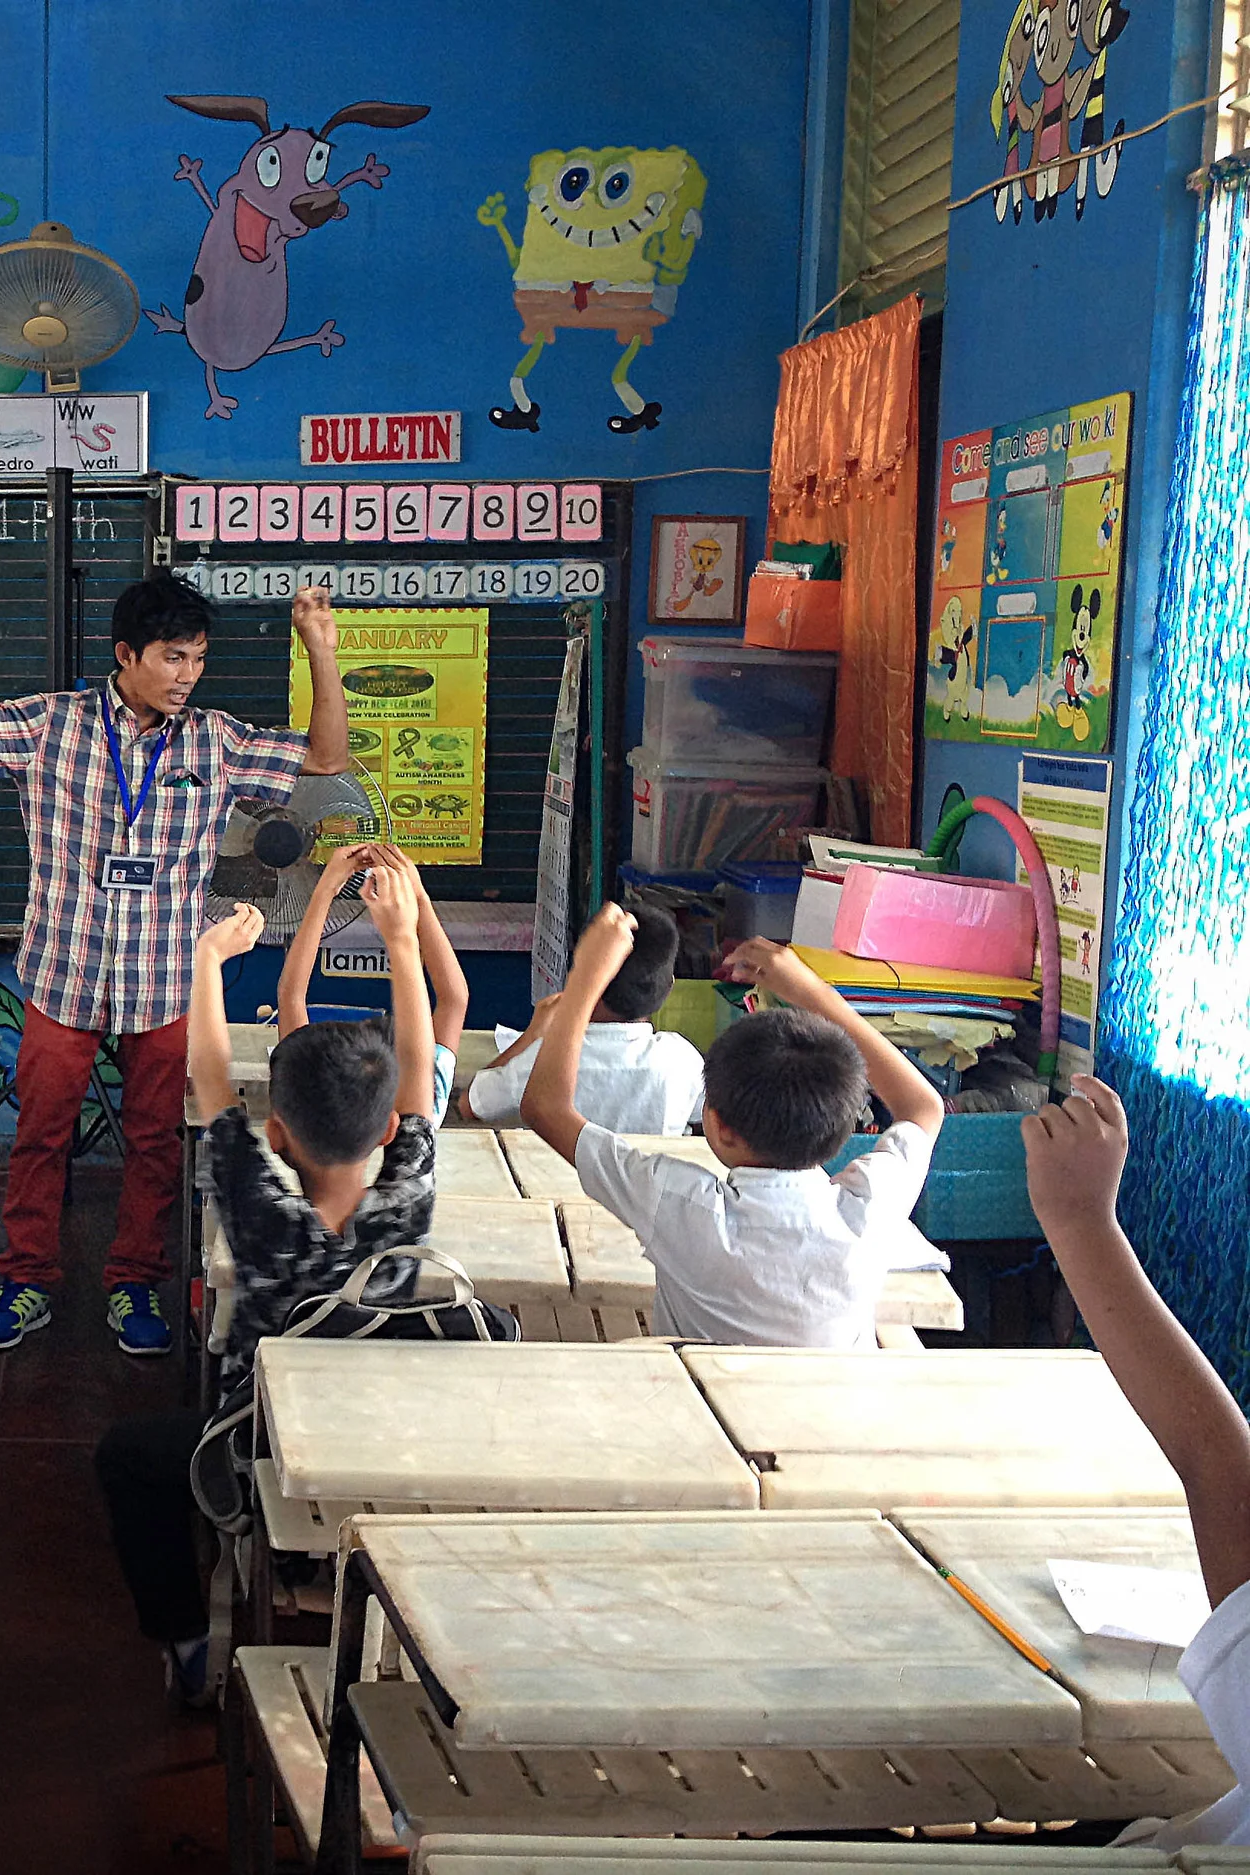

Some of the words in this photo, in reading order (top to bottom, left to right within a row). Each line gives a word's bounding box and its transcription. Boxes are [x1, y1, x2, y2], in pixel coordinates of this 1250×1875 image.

[57, 402, 96, 420] Ww
[310, 415, 452, 463] BULLETIN
[952, 442, 991, 475] Come
[995, 428, 1022, 465] and
[1023, 427, 1048, 457] see
[1052, 421, 1076, 451] our
[189, 497, 203, 529] 1
[228, 497, 248, 528] 2
[270, 498, 289, 530] 3
[311, 496, 334, 529] 4
[355, 498, 376, 531] 5
[395, 492, 419, 528] 6
[439, 496, 462, 529] 7
[483, 496, 504, 528] 8
[525, 493, 549, 528] 9
[565, 499, 596, 524] 10
[221, 572, 248, 595] 12
[263, 573, 290, 596] 13
[348, 573, 375, 596] 15
[392, 573, 419, 596] 16
[434, 572, 462, 595] 17
[477, 570, 505, 594] 18
[523, 571, 550, 595] 19
[565, 569, 599, 593] 20
[363, 711, 382, 719] YEAR
[383, 711, 431, 719] CELEBRATION
[395, 771, 424, 779] AUTISM
[422, 771, 466, 780] AWARENESS
[397, 834, 430, 842] NATIONAL
[431, 834, 461, 842] CANCER
